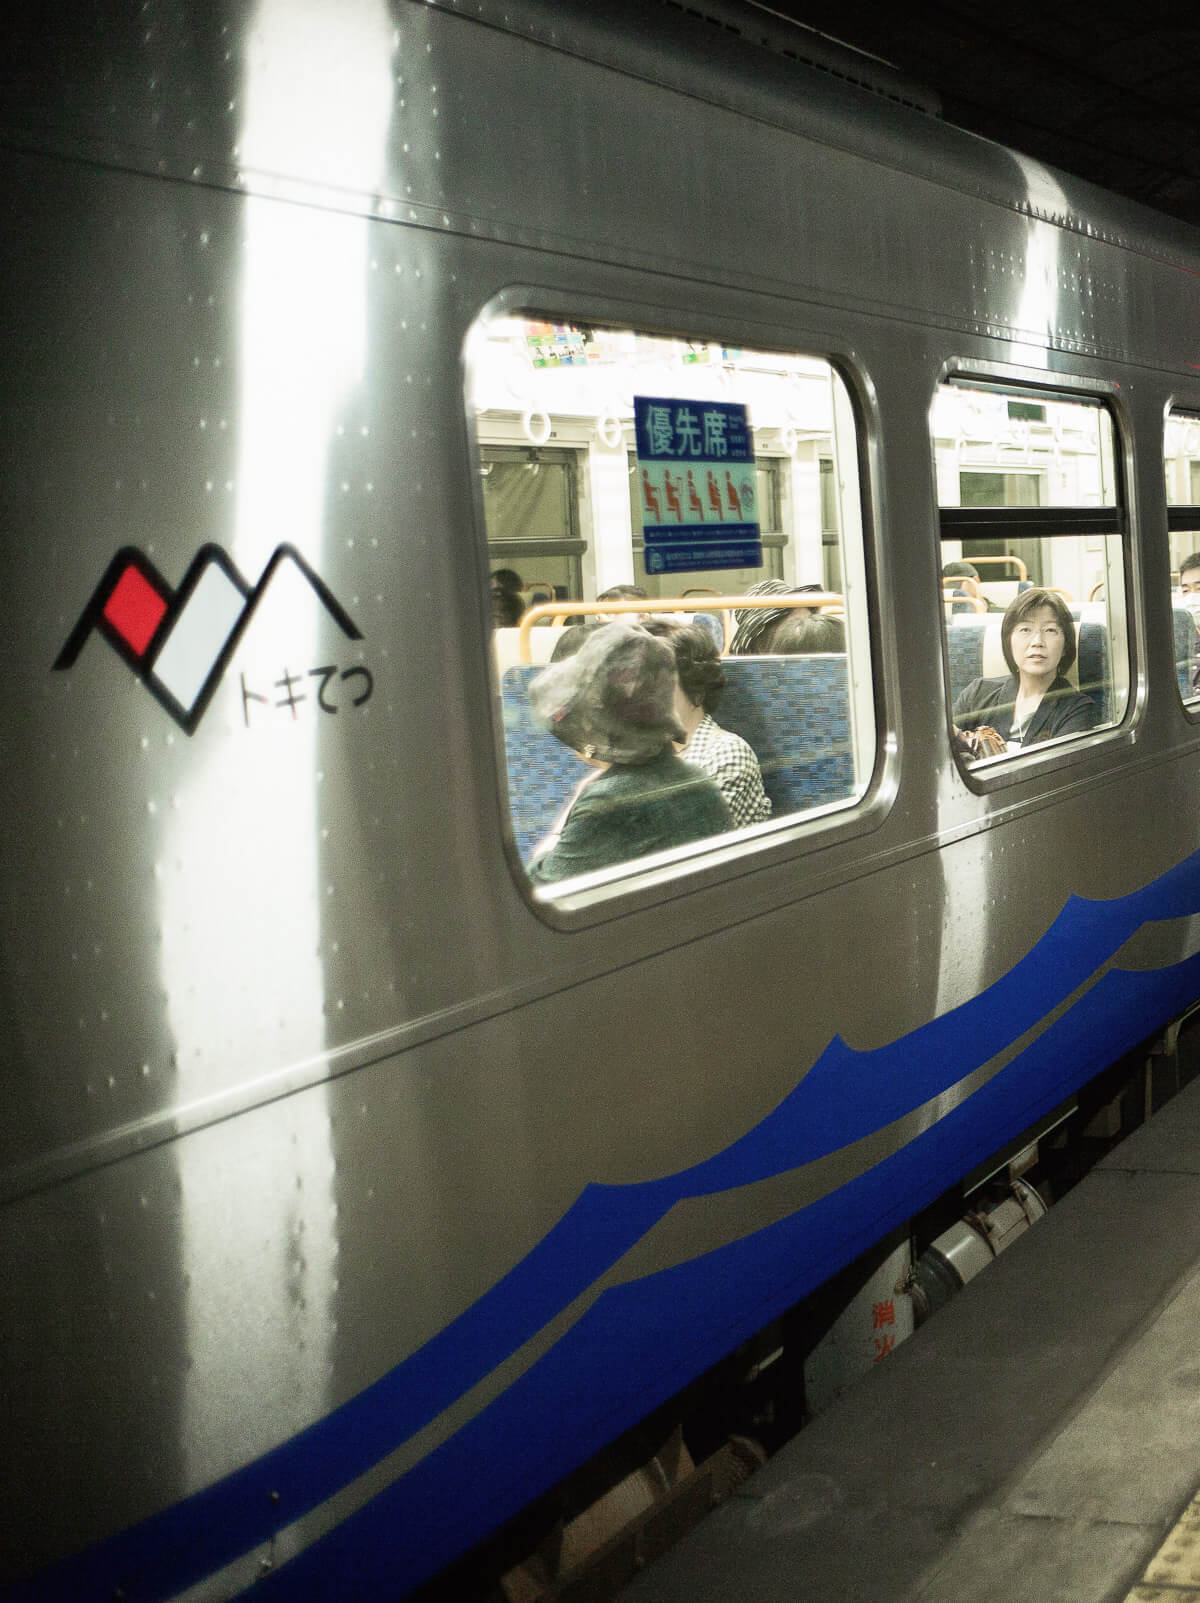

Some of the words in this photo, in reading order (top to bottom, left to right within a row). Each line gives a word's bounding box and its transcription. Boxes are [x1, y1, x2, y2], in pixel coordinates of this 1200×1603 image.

[646, 405, 728, 457] 優先席
[240, 665, 374, 728] トキてつ
